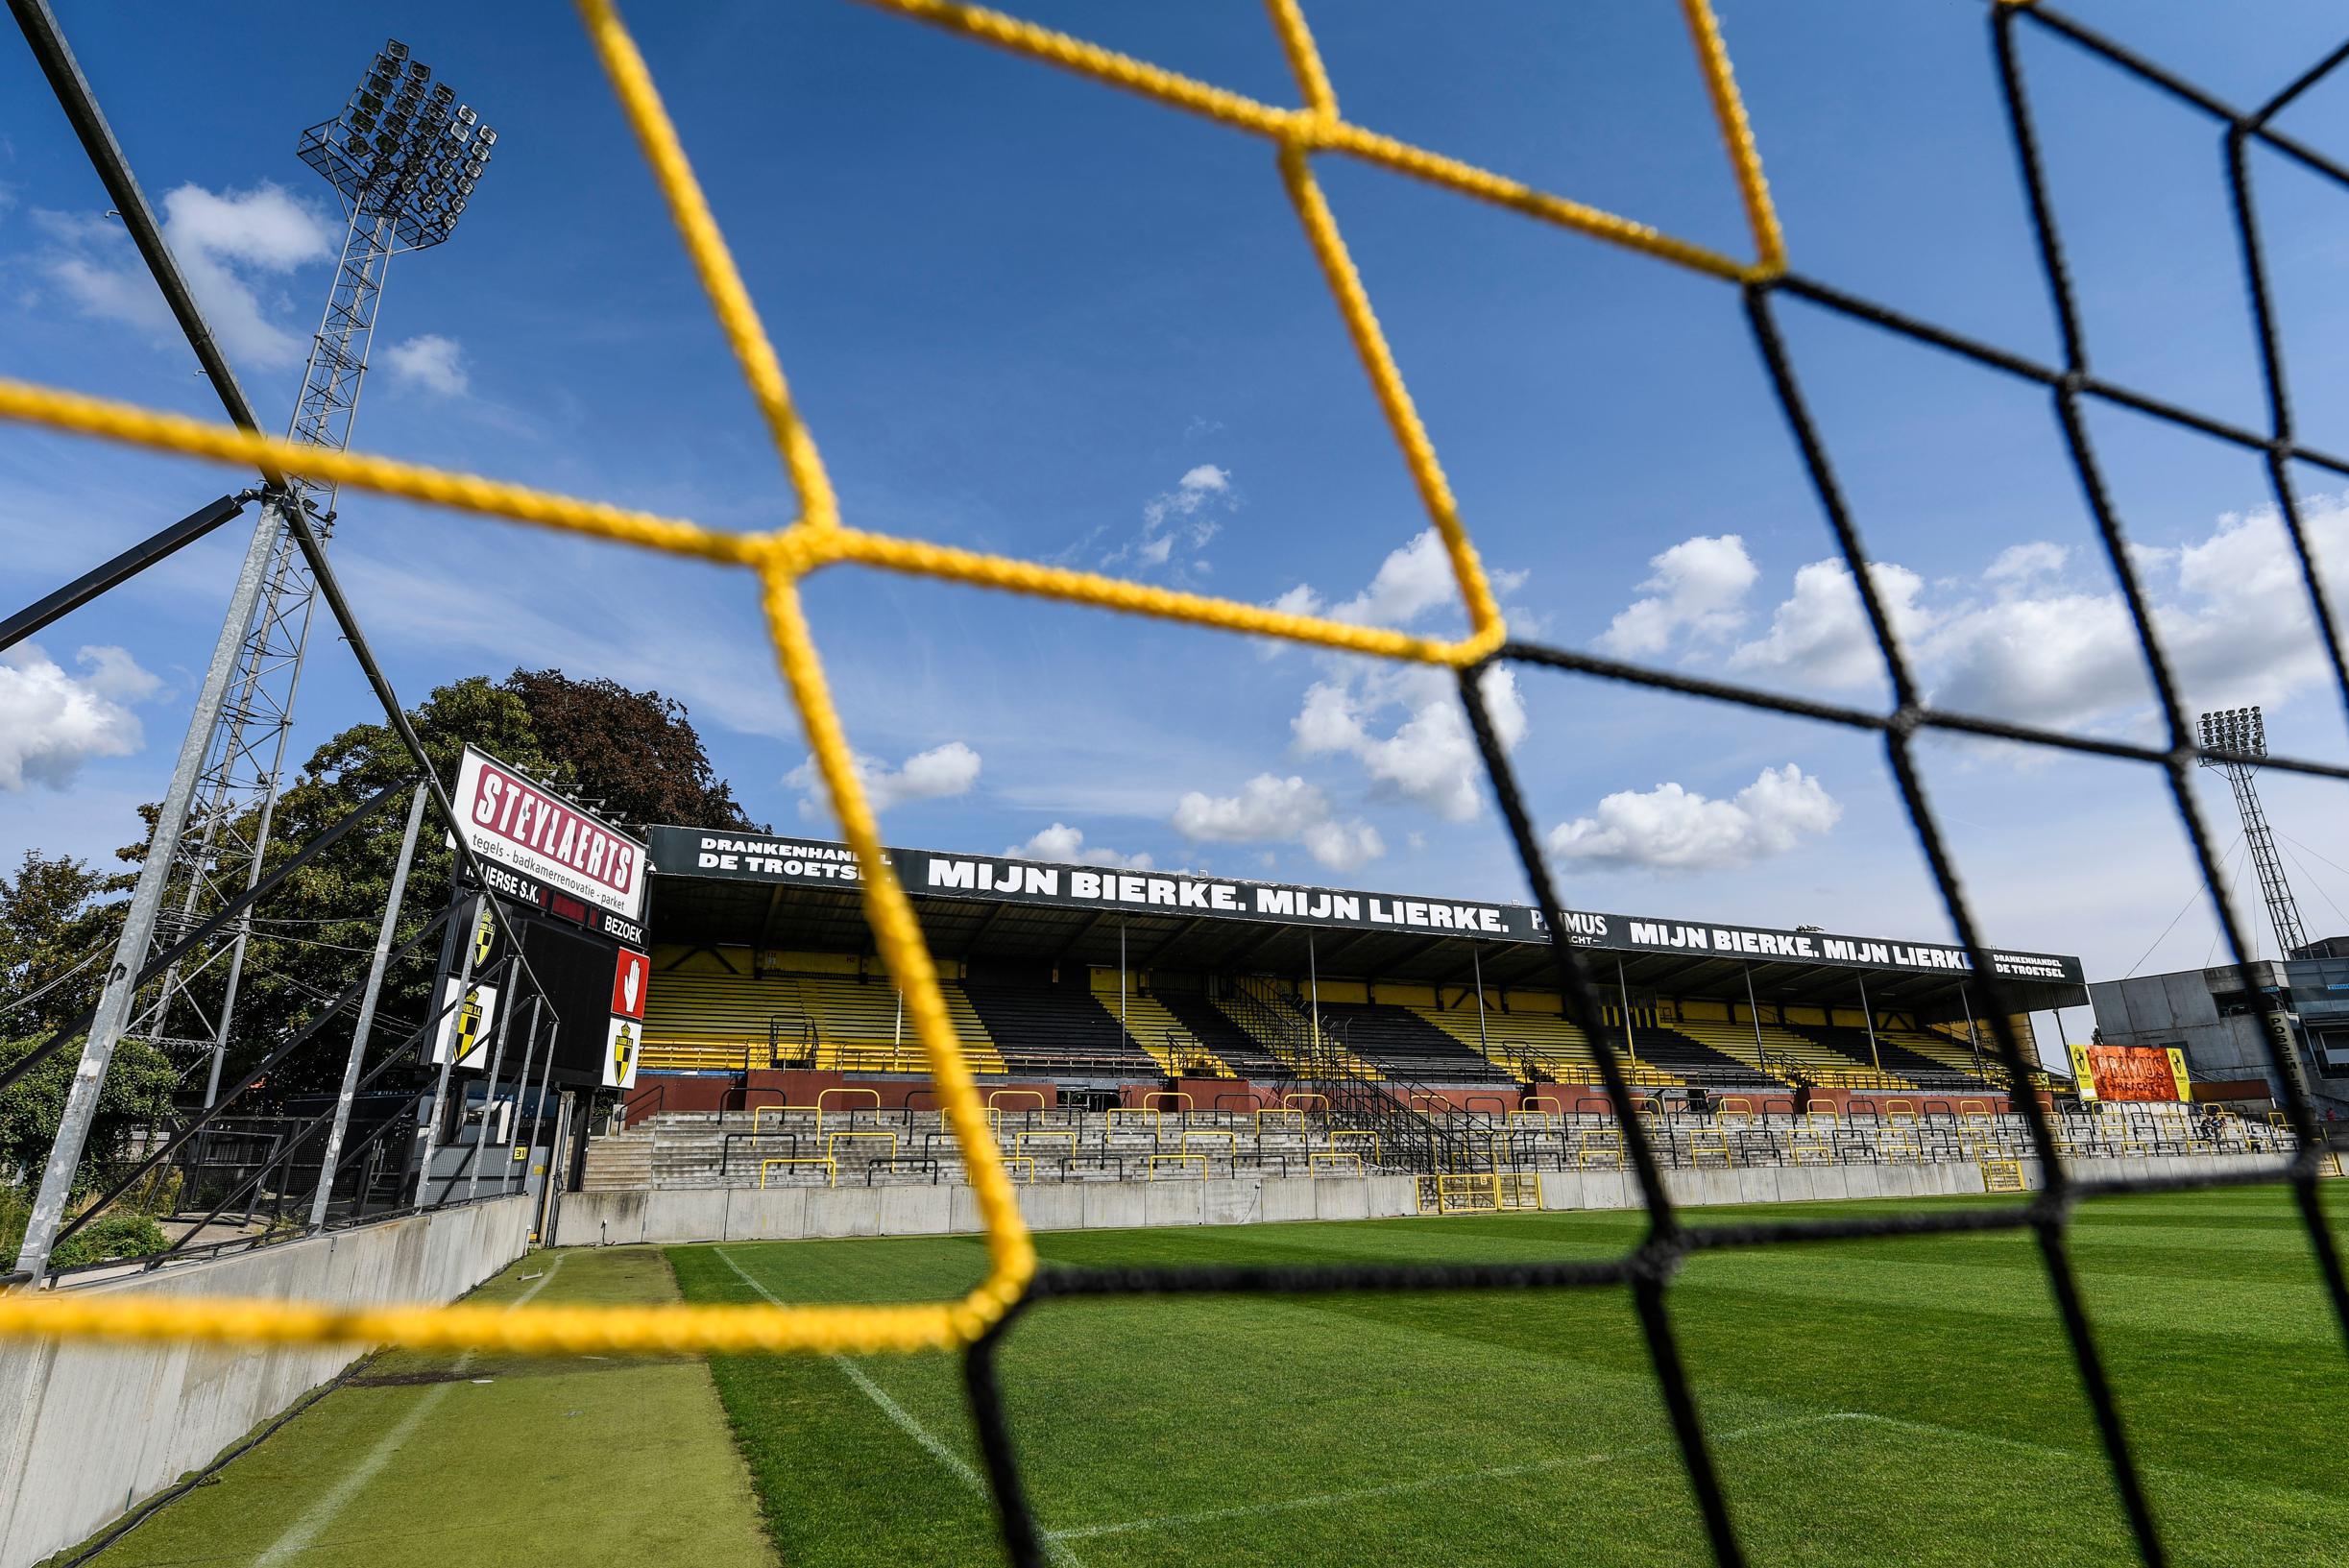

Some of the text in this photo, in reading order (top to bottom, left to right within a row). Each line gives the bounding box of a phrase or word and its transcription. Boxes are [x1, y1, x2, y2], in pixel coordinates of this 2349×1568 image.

[476, 772, 632, 889] STEYLAERTS
[700, 837, 892, 865] DRANKENHANL
[472, 833, 625, 911] tegels badkamerrenovatie parket
[698, 853, 891, 882] DE TROETS
[928, 858, 1510, 933] MIJN BIERKE. MIJN LIERKE.
[604, 915, 642, 944] BEZOEK
[1530, 909, 1609, 936] PMUS
[1629, 922, 1708, 950] MIJN
[1712, 929, 1820, 958] BIERKE.
[1825, 938, 1891, 966] MIJN
[1993, 953, 2063, 968] DRANKENHANDEL
[1996, 963, 2066, 978] DE TROETSEL
[2095, 1055, 2166, 1079] PRIMUS
[515, 1149, 525, 1158] 31
